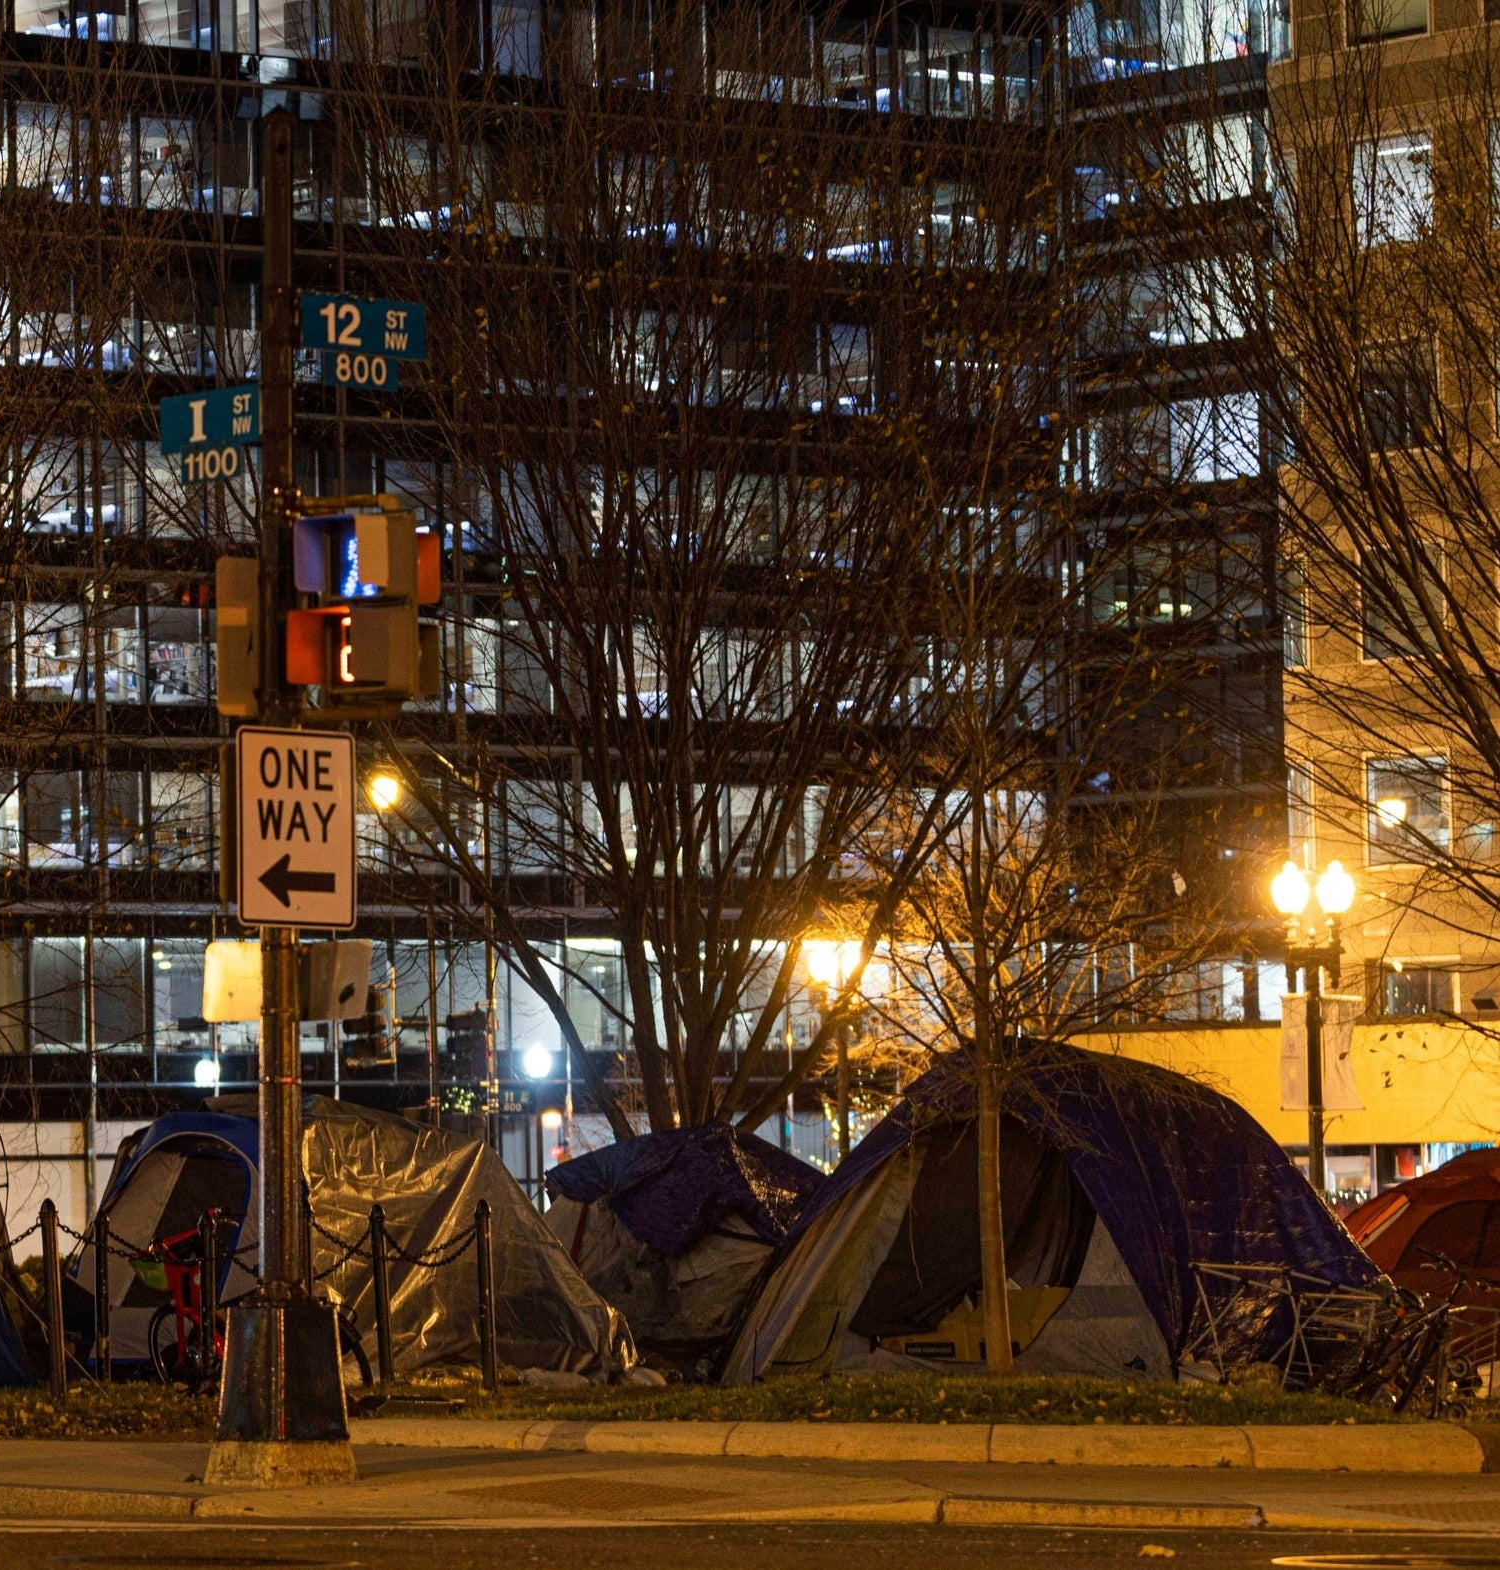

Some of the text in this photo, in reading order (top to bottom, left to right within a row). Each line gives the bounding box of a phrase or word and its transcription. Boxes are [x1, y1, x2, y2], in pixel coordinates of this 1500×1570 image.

[319, 302, 408, 347] 12 ST
[384, 332, 408, 352] NW
[335, 353, 387, 386] 800
[188, 393, 252, 443] I ST
[232, 416, 252, 436] NW
[184, 446, 238, 481] 1100
[261, 747, 333, 790] ONE
[258, 799, 336, 843] WAY
